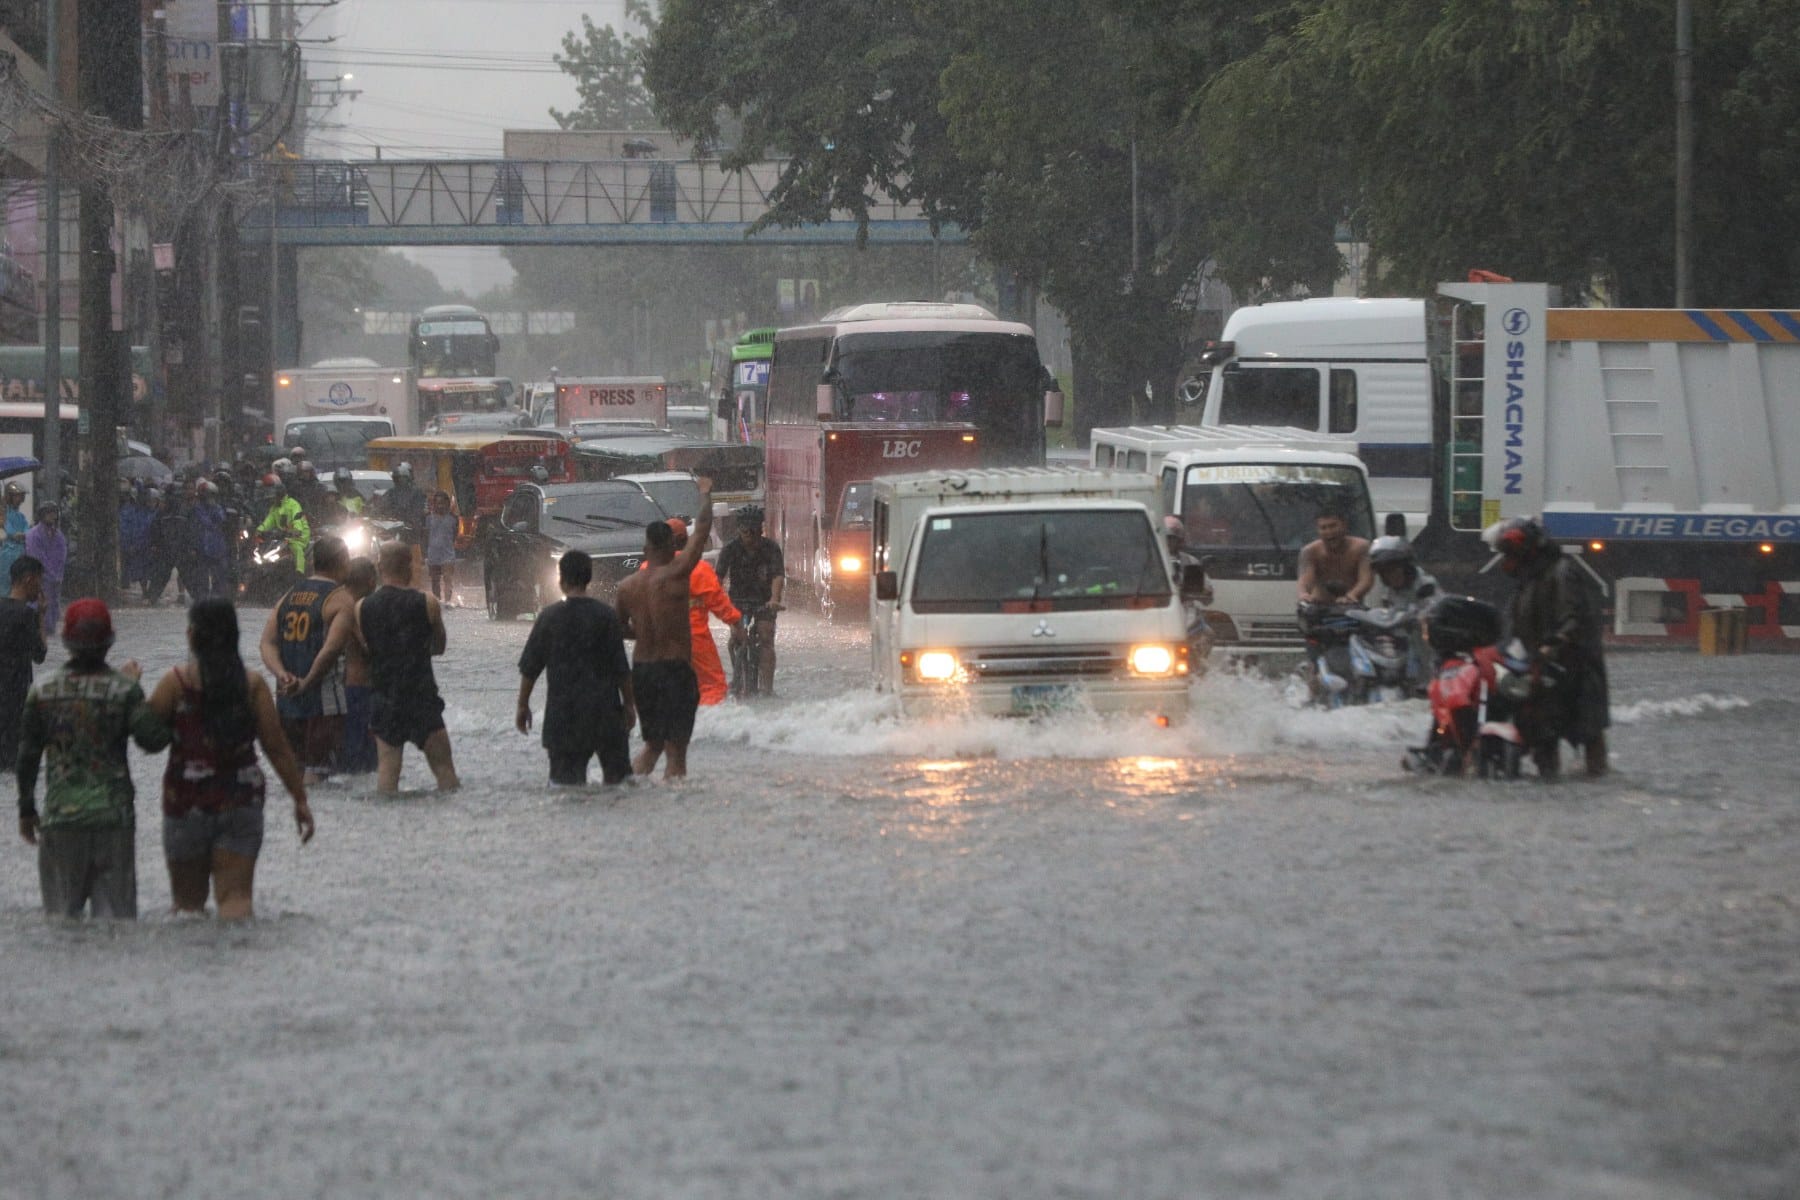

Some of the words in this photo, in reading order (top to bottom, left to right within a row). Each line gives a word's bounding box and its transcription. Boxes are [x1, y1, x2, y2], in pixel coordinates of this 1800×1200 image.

[744, 364, 756, 381] 7
[589, 389, 636, 405] PRESS
[1504, 341, 1525, 495] SHACMAN
[882, 440, 922, 458] LBC
[1612, 518, 1676, 536] THE
[1682, 518, 1800, 538] LEGAC
[283, 610, 311, 642] 30
